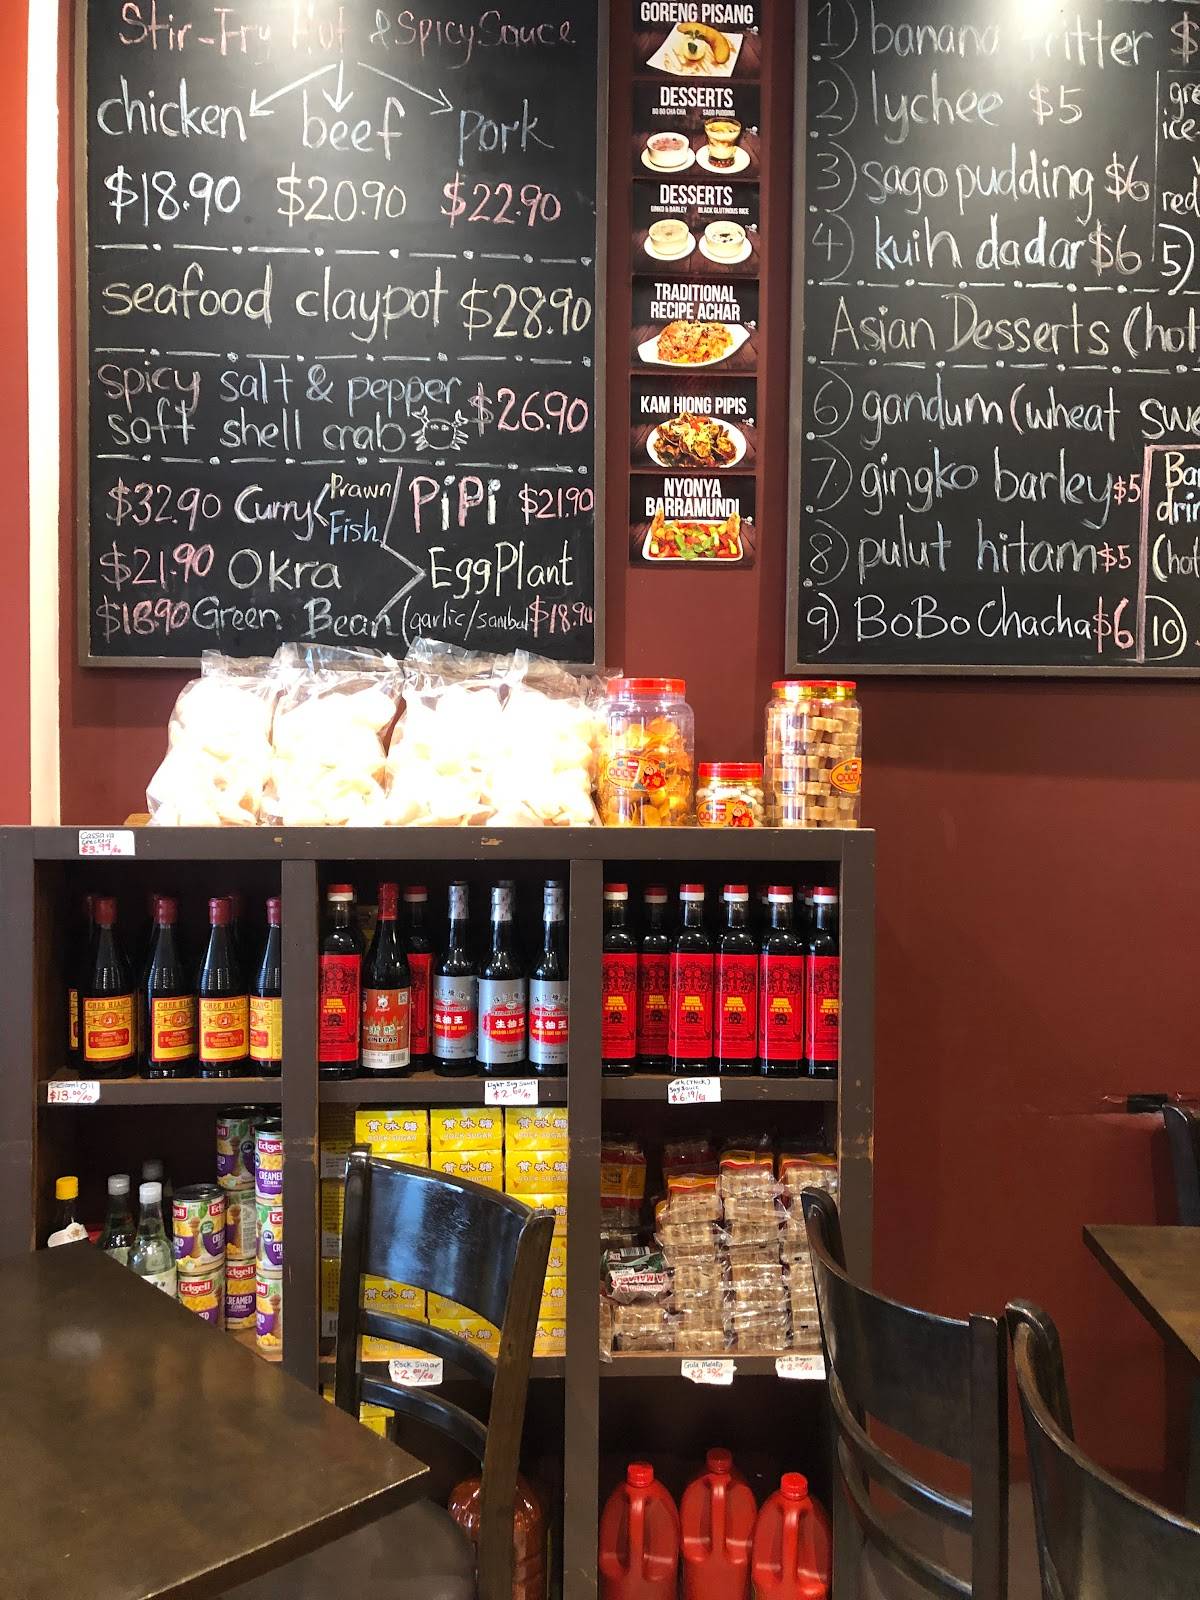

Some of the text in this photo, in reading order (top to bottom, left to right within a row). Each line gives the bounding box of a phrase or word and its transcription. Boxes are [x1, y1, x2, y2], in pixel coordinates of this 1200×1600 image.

[640, 2, 754, 24] GORENG PISANG
[870, 0, 1000, 57] banana
[97, 75, 247, 142] chicken
[303, 89, 405, 160] beef
[660, 86, 733, 108] DESSERTS
[872, 69, 1003, 144] lychee
[1029, 79, 1084, 126] $5
[104, 165, 241, 227] $18.90
[276, 162, 406, 227] $20.90
[440, 170, 562, 228] $22.90
[660, 184, 733, 206] DESSERTS
[1104, 151, 1150, 203] $6
[875, 216, 963, 270] kuih
[976, 212, 1086, 270] dadar
[1088, 218, 1142, 277] $6
[102, 261, 592, 343] seafood claypot $28.90
[650, 302, 740, 320] RECIPE ACHAR
[654, 283, 737, 302] TRADITIONAL
[830, 293, 1200, 359] Asian Desserts (hot
[108, 397, 406, 452] soft shell crab
[220, 359, 294, 404] salt
[305, 364, 334, 404] &
[348, 376, 462, 418] pepper
[468, 382, 589, 437] $26.90
[640, 396, 747, 414] KAM HIONG PIPIS
[859, 373, 1003, 450] gandum
[106, 477, 314, 541] $32.90 Curry
[331, 472, 392, 500] Prawn
[518, 483, 594, 525] $21.90
[645, 497, 740, 518] BARRAMUNDI
[664, 478, 722, 498] NYONYA
[860, 446, 979, 516] gingko
[994, 446, 1113, 530] barley
[1113, 474, 1141, 505] $5
[329, 509, 377, 545] Fish
[858, 515, 952, 585] pulut
[978, 518, 1098, 576] hitam
[1097, 541, 1132, 573] $5
[99, 541, 342, 592] $21.90 Okra
[302, 597, 399, 639] Bean
[1092, 596, 1134, 653] $6
[180, 1283, 210, 1295] Edgell
[394, 1360, 440, 1372] Rock Sugar
